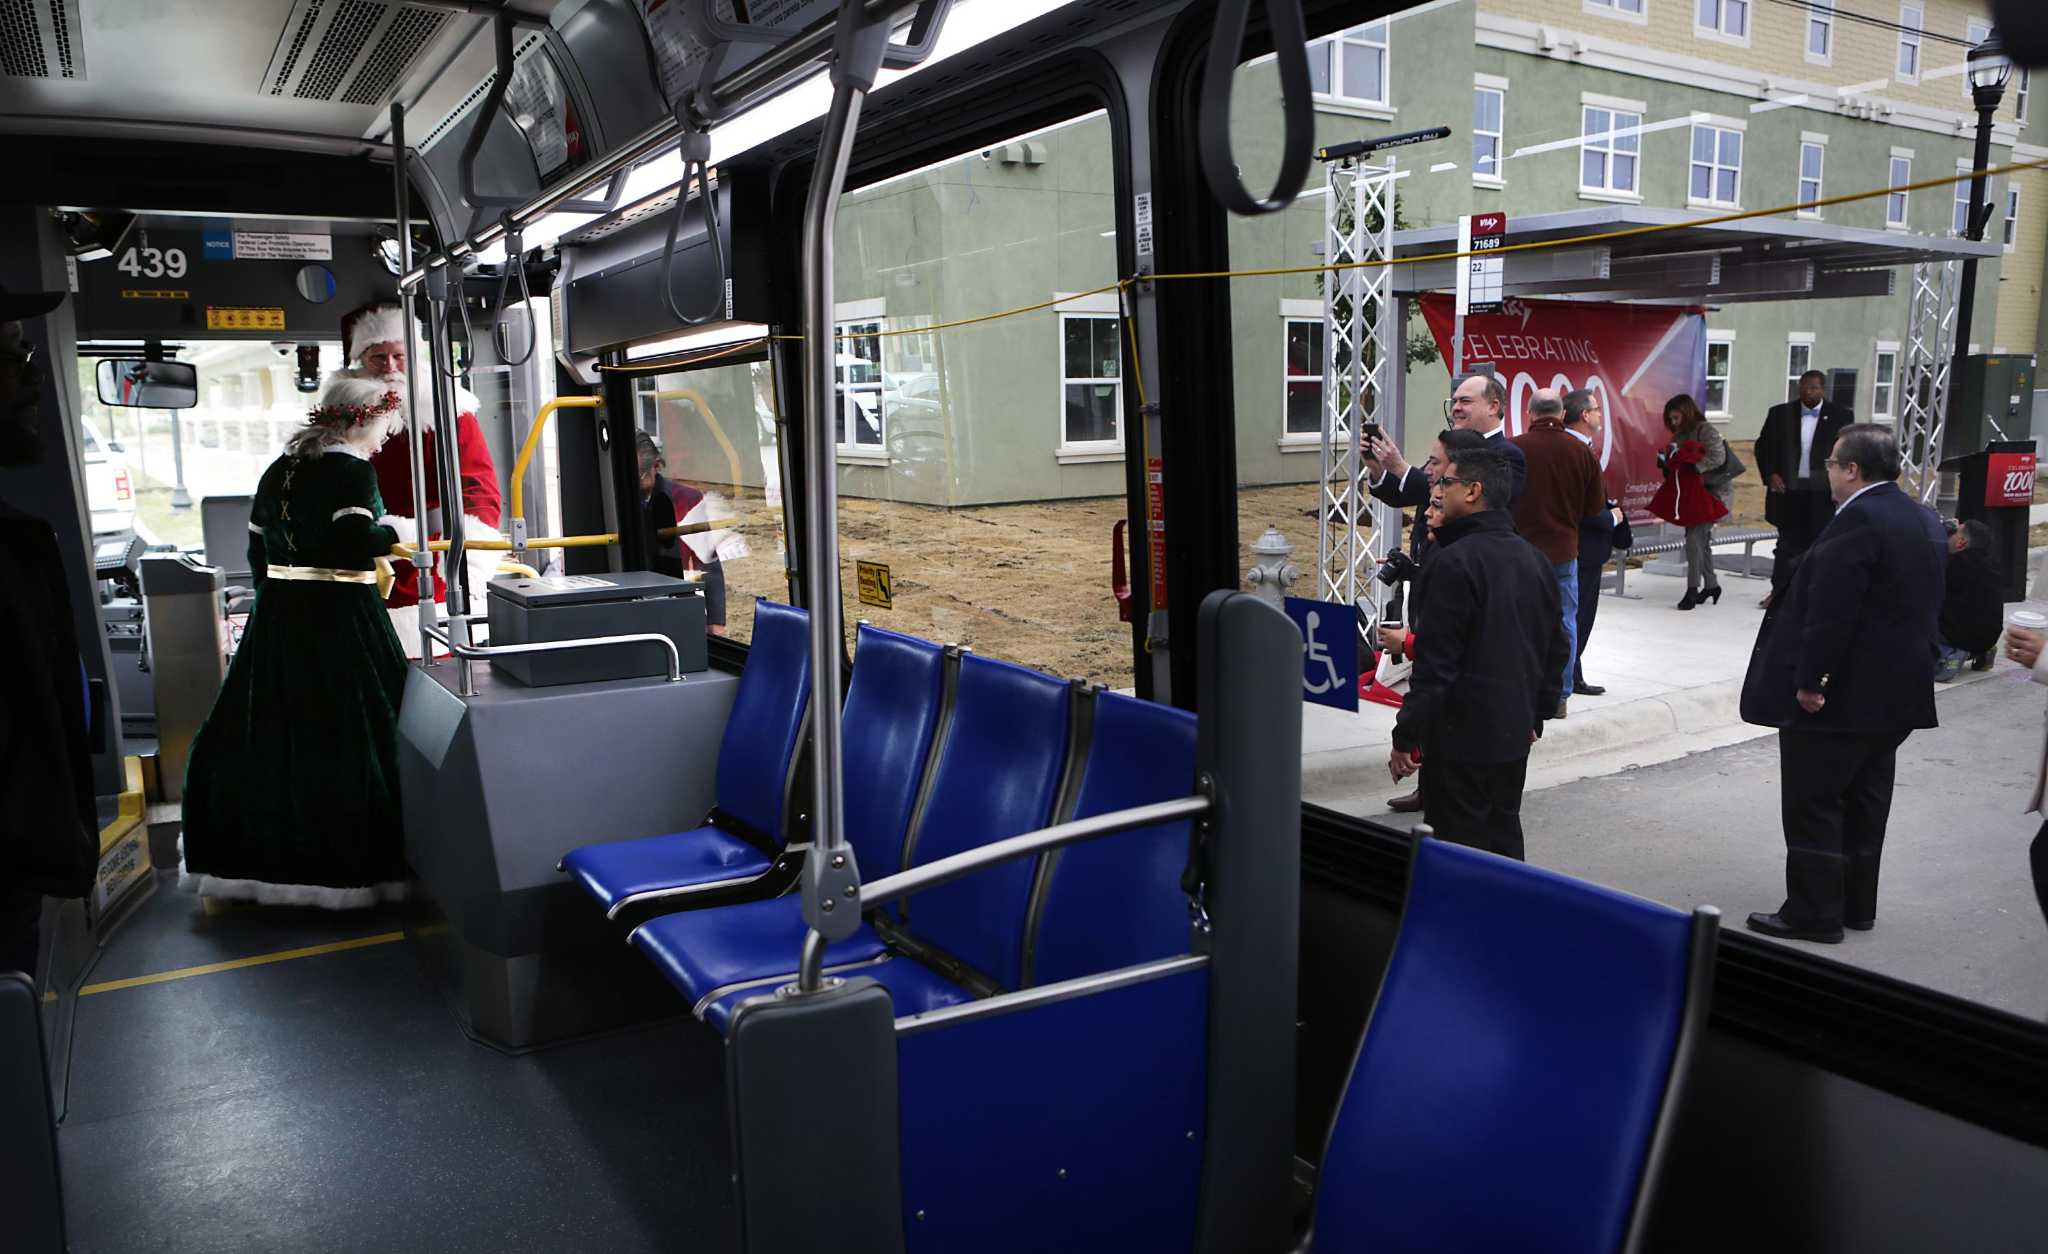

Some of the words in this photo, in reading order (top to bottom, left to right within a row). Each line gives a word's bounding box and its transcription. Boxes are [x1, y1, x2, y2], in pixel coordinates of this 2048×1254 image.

[1480, 217, 1495, 228] VIA
[1474, 238, 1500, 249] 71689
[118, 247, 187, 278] 439
[1472, 262, 1482, 272] 22
